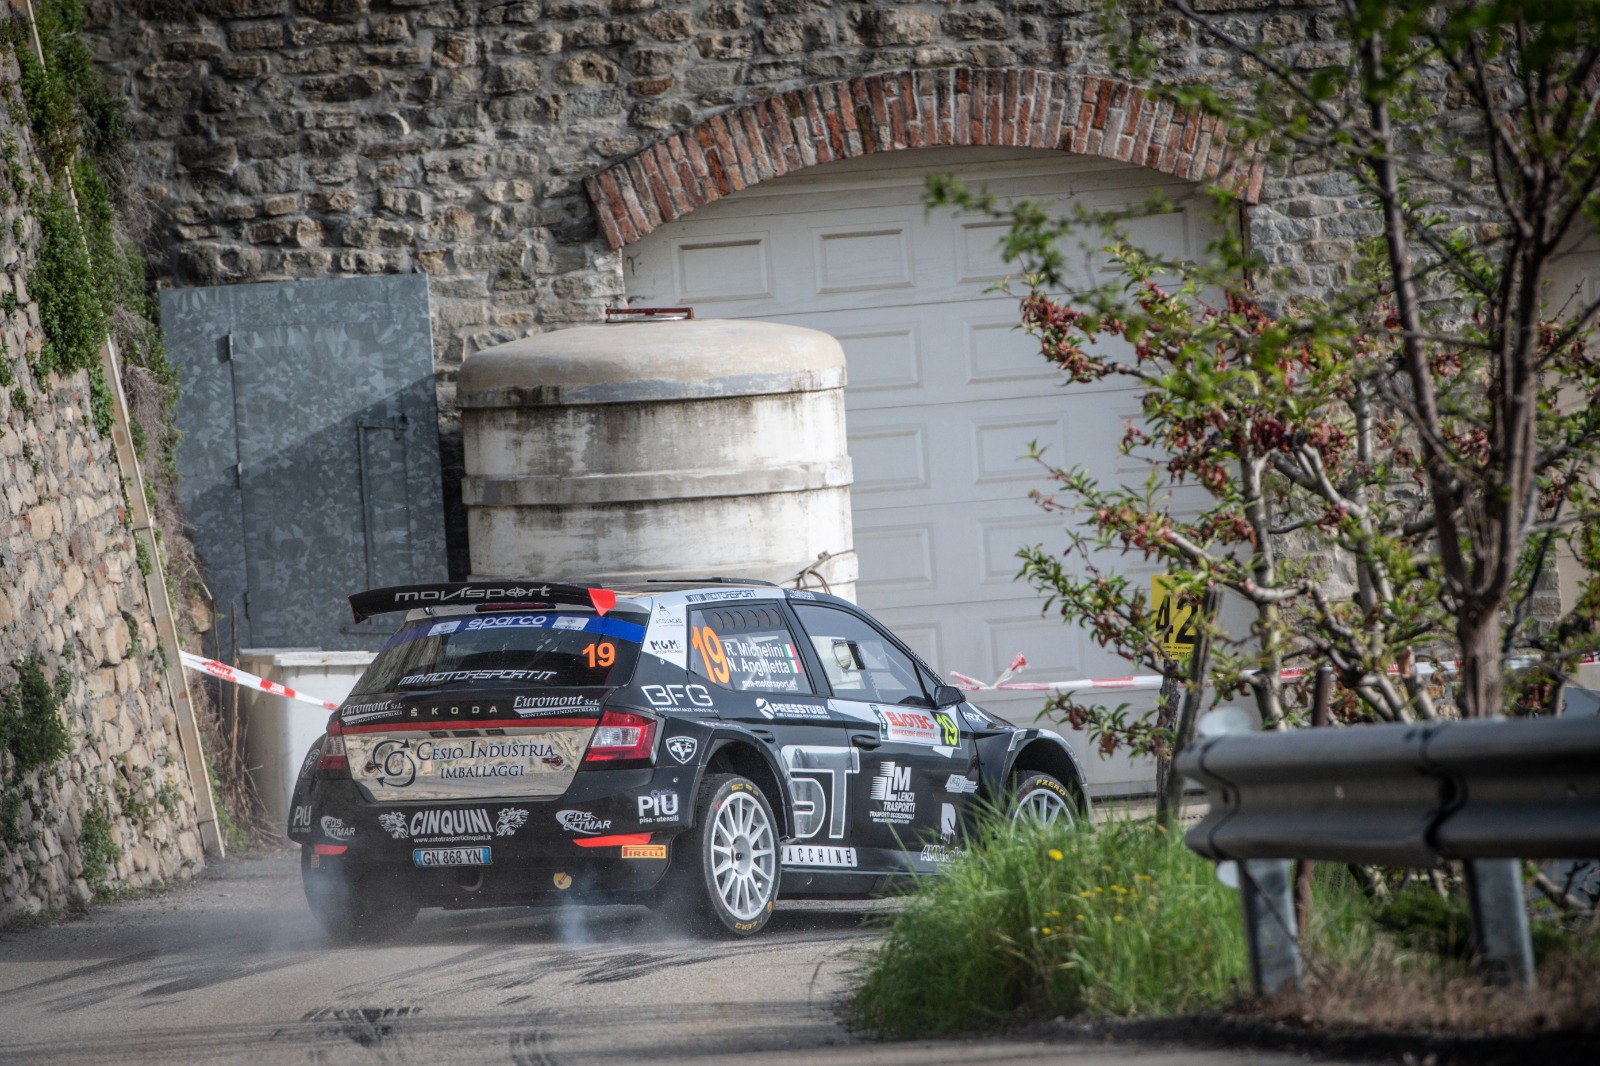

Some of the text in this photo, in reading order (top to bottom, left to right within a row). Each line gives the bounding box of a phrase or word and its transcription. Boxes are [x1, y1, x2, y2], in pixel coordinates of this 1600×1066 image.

[395, 585, 551, 602] movisport
[467, 615, 547, 631] sparco
[1156, 594, 1199, 645] 42
[582, 642, 616, 668] 19
[692, 625, 730, 684] 19
[724, 642, 785, 658] R. Michelini
[726, 657, 740, 672] N.
[398, 670, 557, 686] MM-MOTORSPORT.IT
[513, 695, 584, 708] Euromont
[641, 684, 713, 706] BFG
[341, 700, 391, 716] Euromont
[520, 710, 556, 719] MONTAGGI
[771, 703, 828, 715] PRESSTUBI
[885, 711, 935, 730] ELIOTEC
[935, 713, 959, 746] 19
[469, 740, 555, 759] INDUSTRIA
[440, 765, 525, 779] IMBALLAGGI
[897, 791, 915, 802] LENZI
[883, 801, 916, 813] TRASPORTI
[410, 808, 494, 836] CINQUINI
[639, 816, 652, 824] pisa
[656, 814, 679, 823] utensili
[413, 833, 492, 843] www.autotrasporticinquini.it
[423, 849, 482, 865] GN 868 YN
[622, 846, 664, 857] PIRELLI
